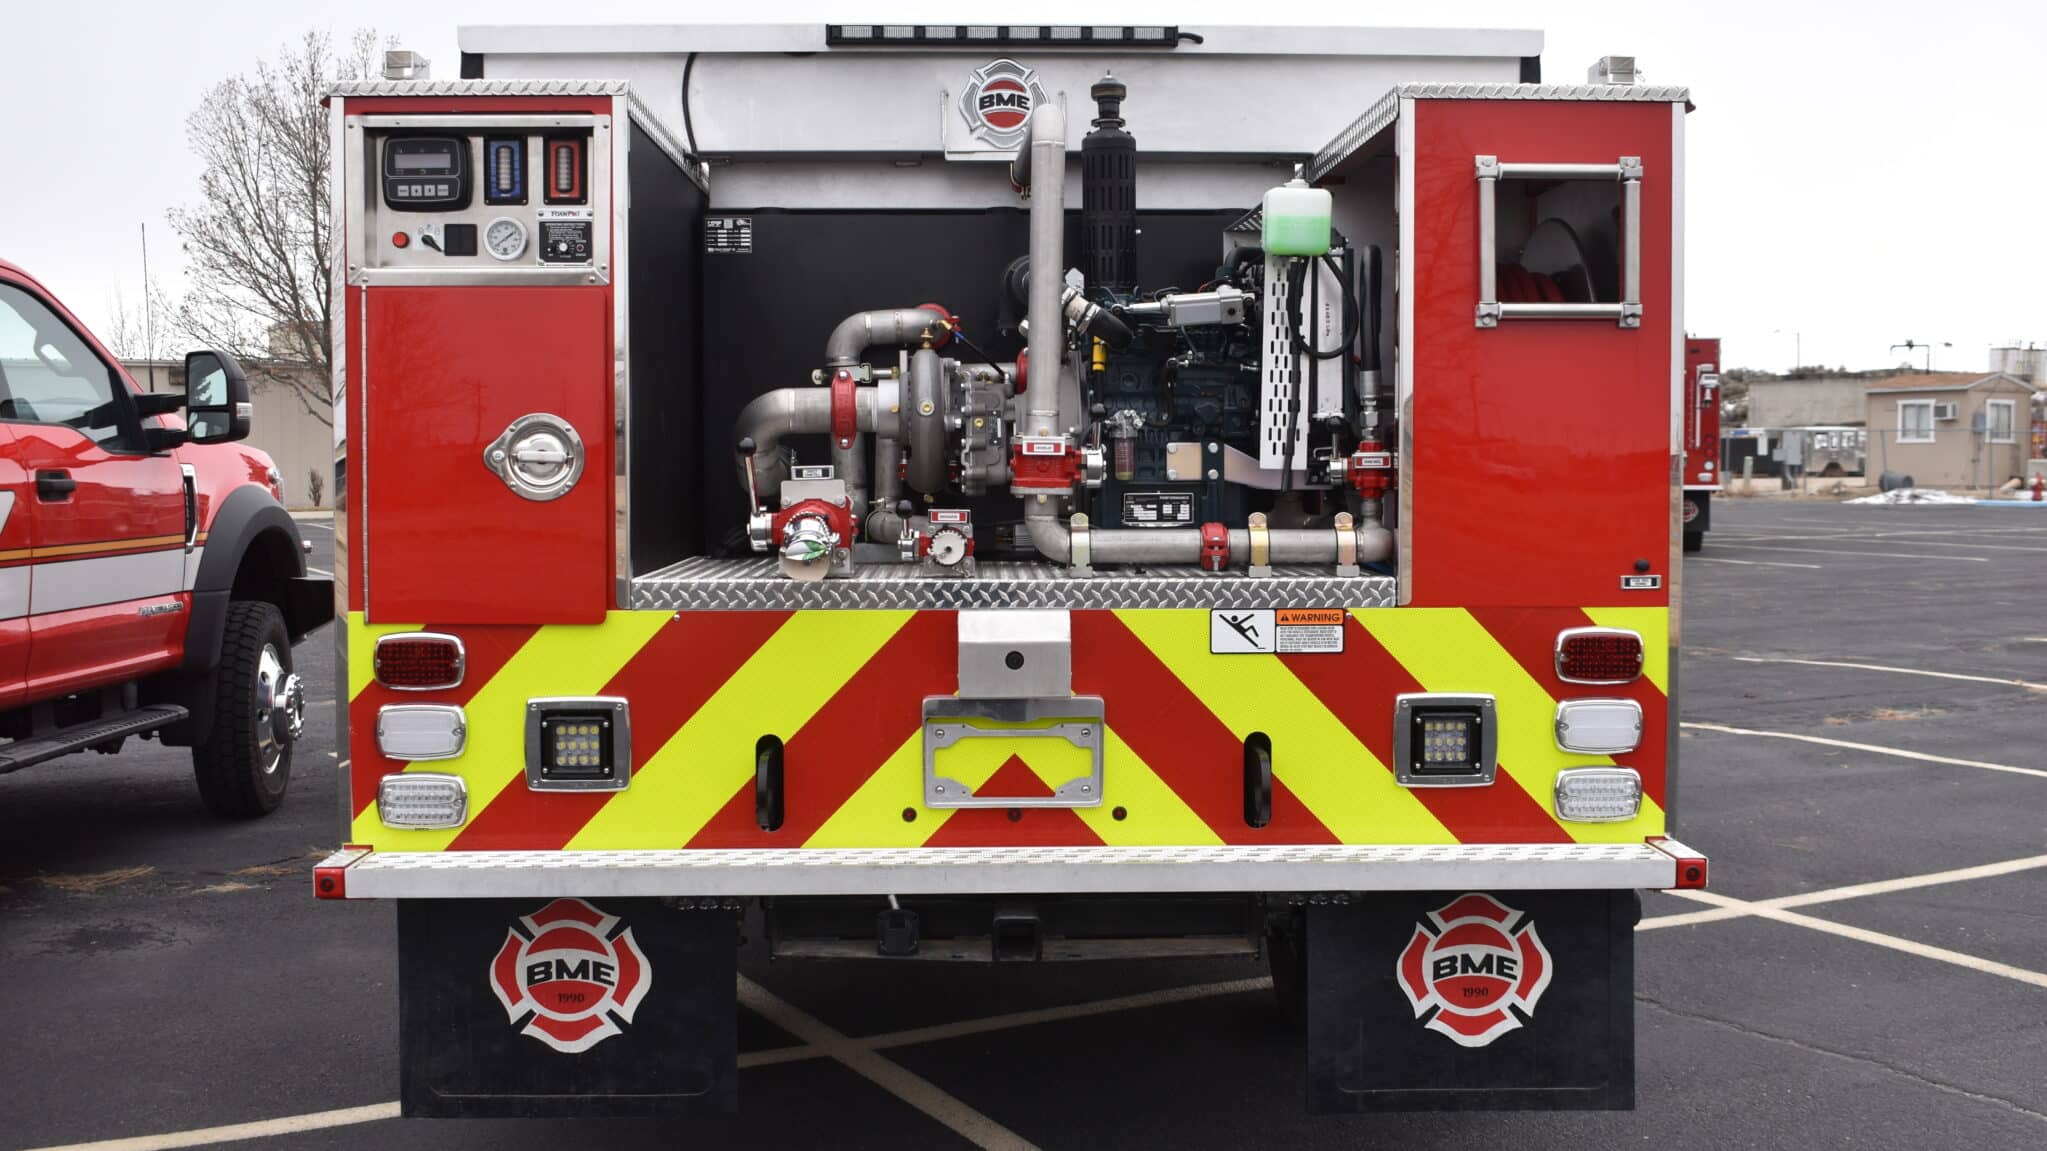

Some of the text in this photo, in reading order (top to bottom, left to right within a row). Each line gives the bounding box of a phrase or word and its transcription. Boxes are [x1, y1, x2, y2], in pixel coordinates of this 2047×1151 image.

[979, 93, 1030, 110] BME
[1291, 613, 1340, 622] WARNING
[526, 958, 615, 987] BME
[1433, 953, 1517, 981] BME
[558, 993, 585, 1004] 1990
[1462, 987, 1489, 998] 1990
